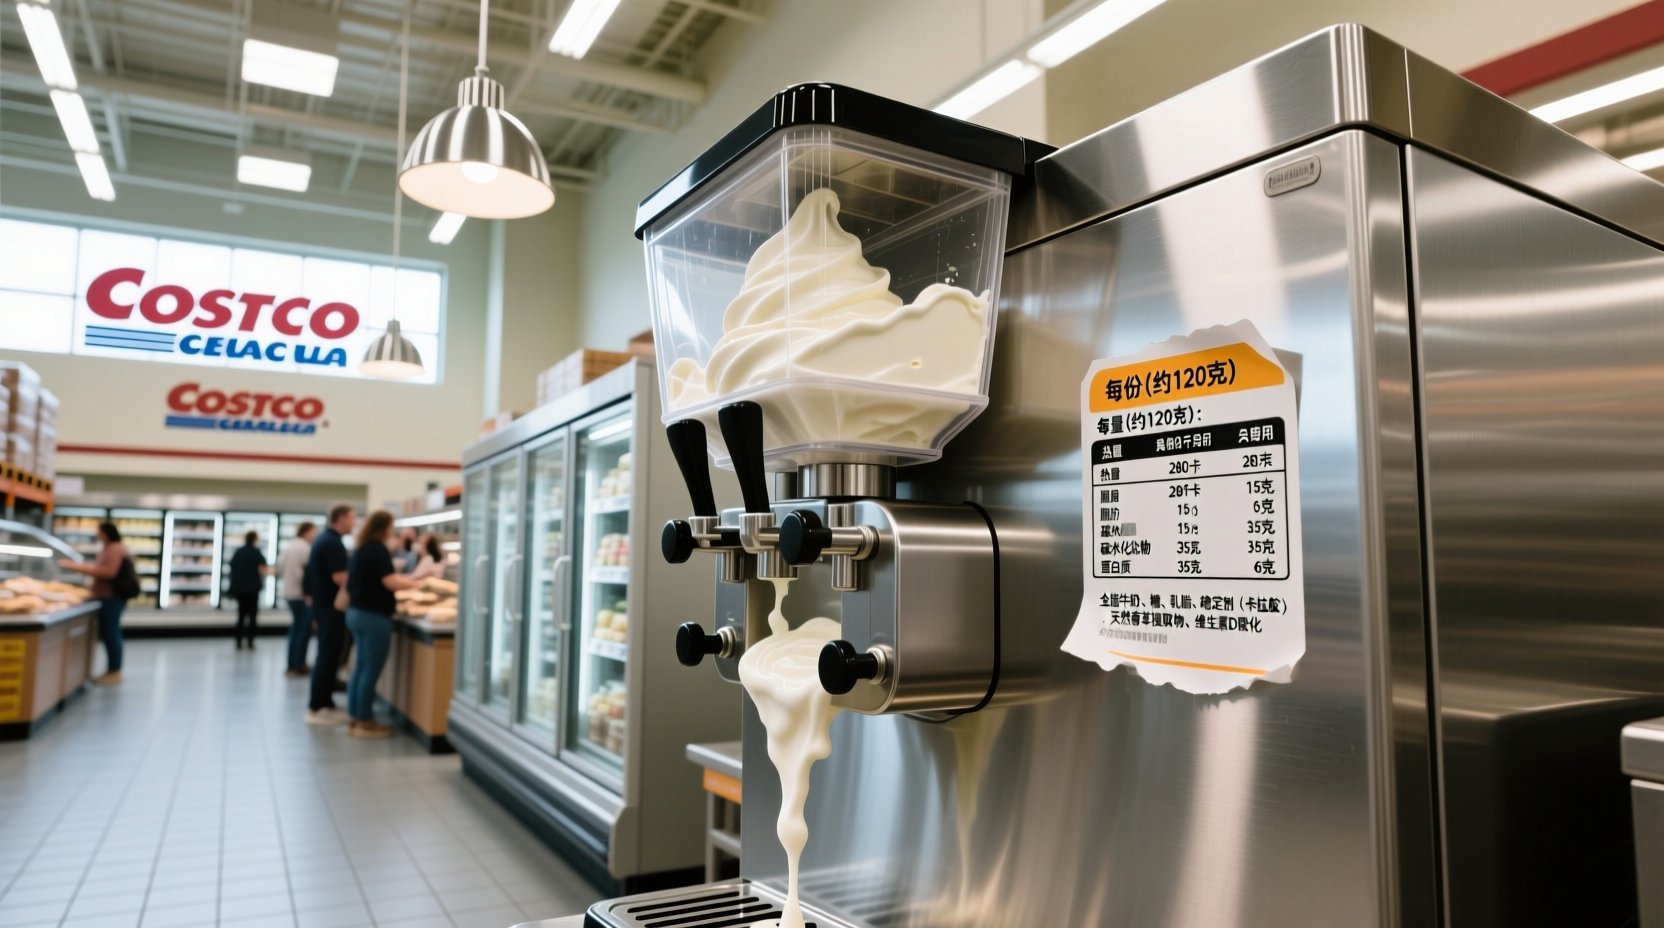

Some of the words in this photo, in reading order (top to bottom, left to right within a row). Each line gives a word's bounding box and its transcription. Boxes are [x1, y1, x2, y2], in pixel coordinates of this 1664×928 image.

[86, 267, 360, 340] COSTCO
[1105, 358, 1236, 402] 每份(约120克)
[1246, 477, 1275, 494] 15克
[1253, 498, 1275, 514] 6克
[1247, 518, 1276, 535] 35克
[1253, 557, 1276, 575] 6克
